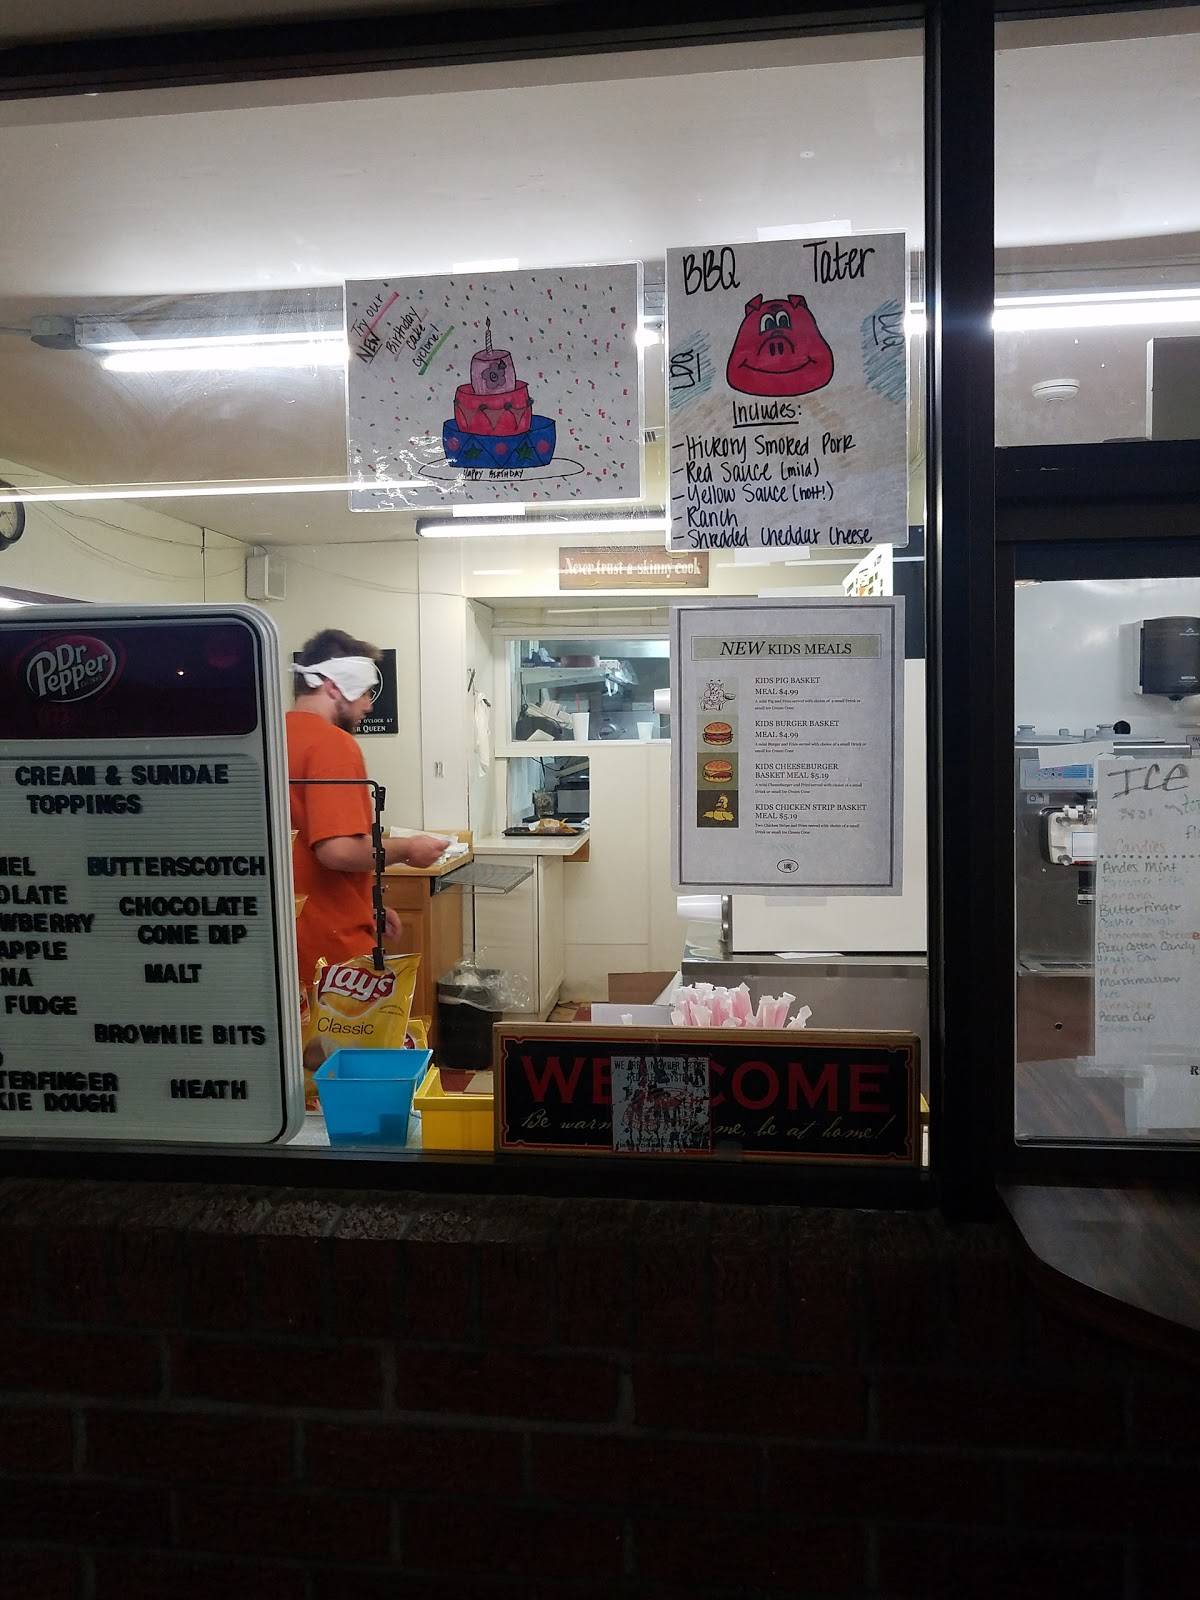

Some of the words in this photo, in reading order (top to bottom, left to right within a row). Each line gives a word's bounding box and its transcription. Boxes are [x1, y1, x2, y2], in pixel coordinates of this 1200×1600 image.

[682, 247, 740, 295] BBQ
[803, 240, 875, 284] Tater
[351, 318, 373, 338] Try
[366, 294, 383, 317] our
[386, 306, 422, 354] Birthday
[356, 331, 381, 364] NEW
[732, 401, 802, 426] Includes:
[686, 435, 747, 463] Hickory
[754, 434, 809, 457] Smoked
[822, 432, 856, 456] Pork
[489, 469, 524, 479] BIRTHDAY
[686, 461, 712, 484] Red
[722, 461, 772, 483] Sauce
[781, 458, 819, 480] (mild)
[687, 487, 735, 511] Yellow
[742, 484, 792, 502] Sauce
[687, 507, 738, 527] Ranch
[687, 526, 749, 548] Shredded
[761, 526, 819, 546] Cheddar
[829, 525, 873, 545] Cheese
[597, 560, 623, 575] trust
[626, 565, 633, 575] a
[637, 559, 672, 578] skinny
[675, 557, 701, 575] cook
[56, 644, 87, 672] Dr
[720, 641, 766, 656] NEW
[768, 643, 801, 655] KIDS
[804, 643, 852, 655] MEALS
[28, 651, 109, 697] Pepper
[790, 676, 821, 684] BASKET
[778, 688, 799, 696] $4.99
[363, 725, 386, 733] QUEEN
[779, 731, 799, 739] $4.99
[15, 765, 96, 786] CREAM
[105, 766, 122, 786] &
[132, 764, 229, 785] SUNDAE
[811, 772, 829, 780] $5.19
[27, 794, 142, 814] TOPPINGS
[87, 857, 266, 877] BUTTERSCOTCH
[119, 896, 258, 916] CHOCOLATE
[138, 925, 199, 944] CONE
[208, 925, 247, 944] DIP
[144, 964, 202, 983] MALT
[5, 996, 78, 1015] FUDGE
[94, 1024, 202, 1044] BROWNIE
[212, 1025, 266, 1045] BITS
[317, 1017, 374, 1035] Classic
[170, 1079, 247, 1099] HEATH
[44, 1093, 117, 1113] DOUGH
[521, 1108, 551, 1129] Be
[756, 1116, 777, 1137] be
[786, 1120, 816, 1139] at
[822, 1113, 896, 1140] home!
